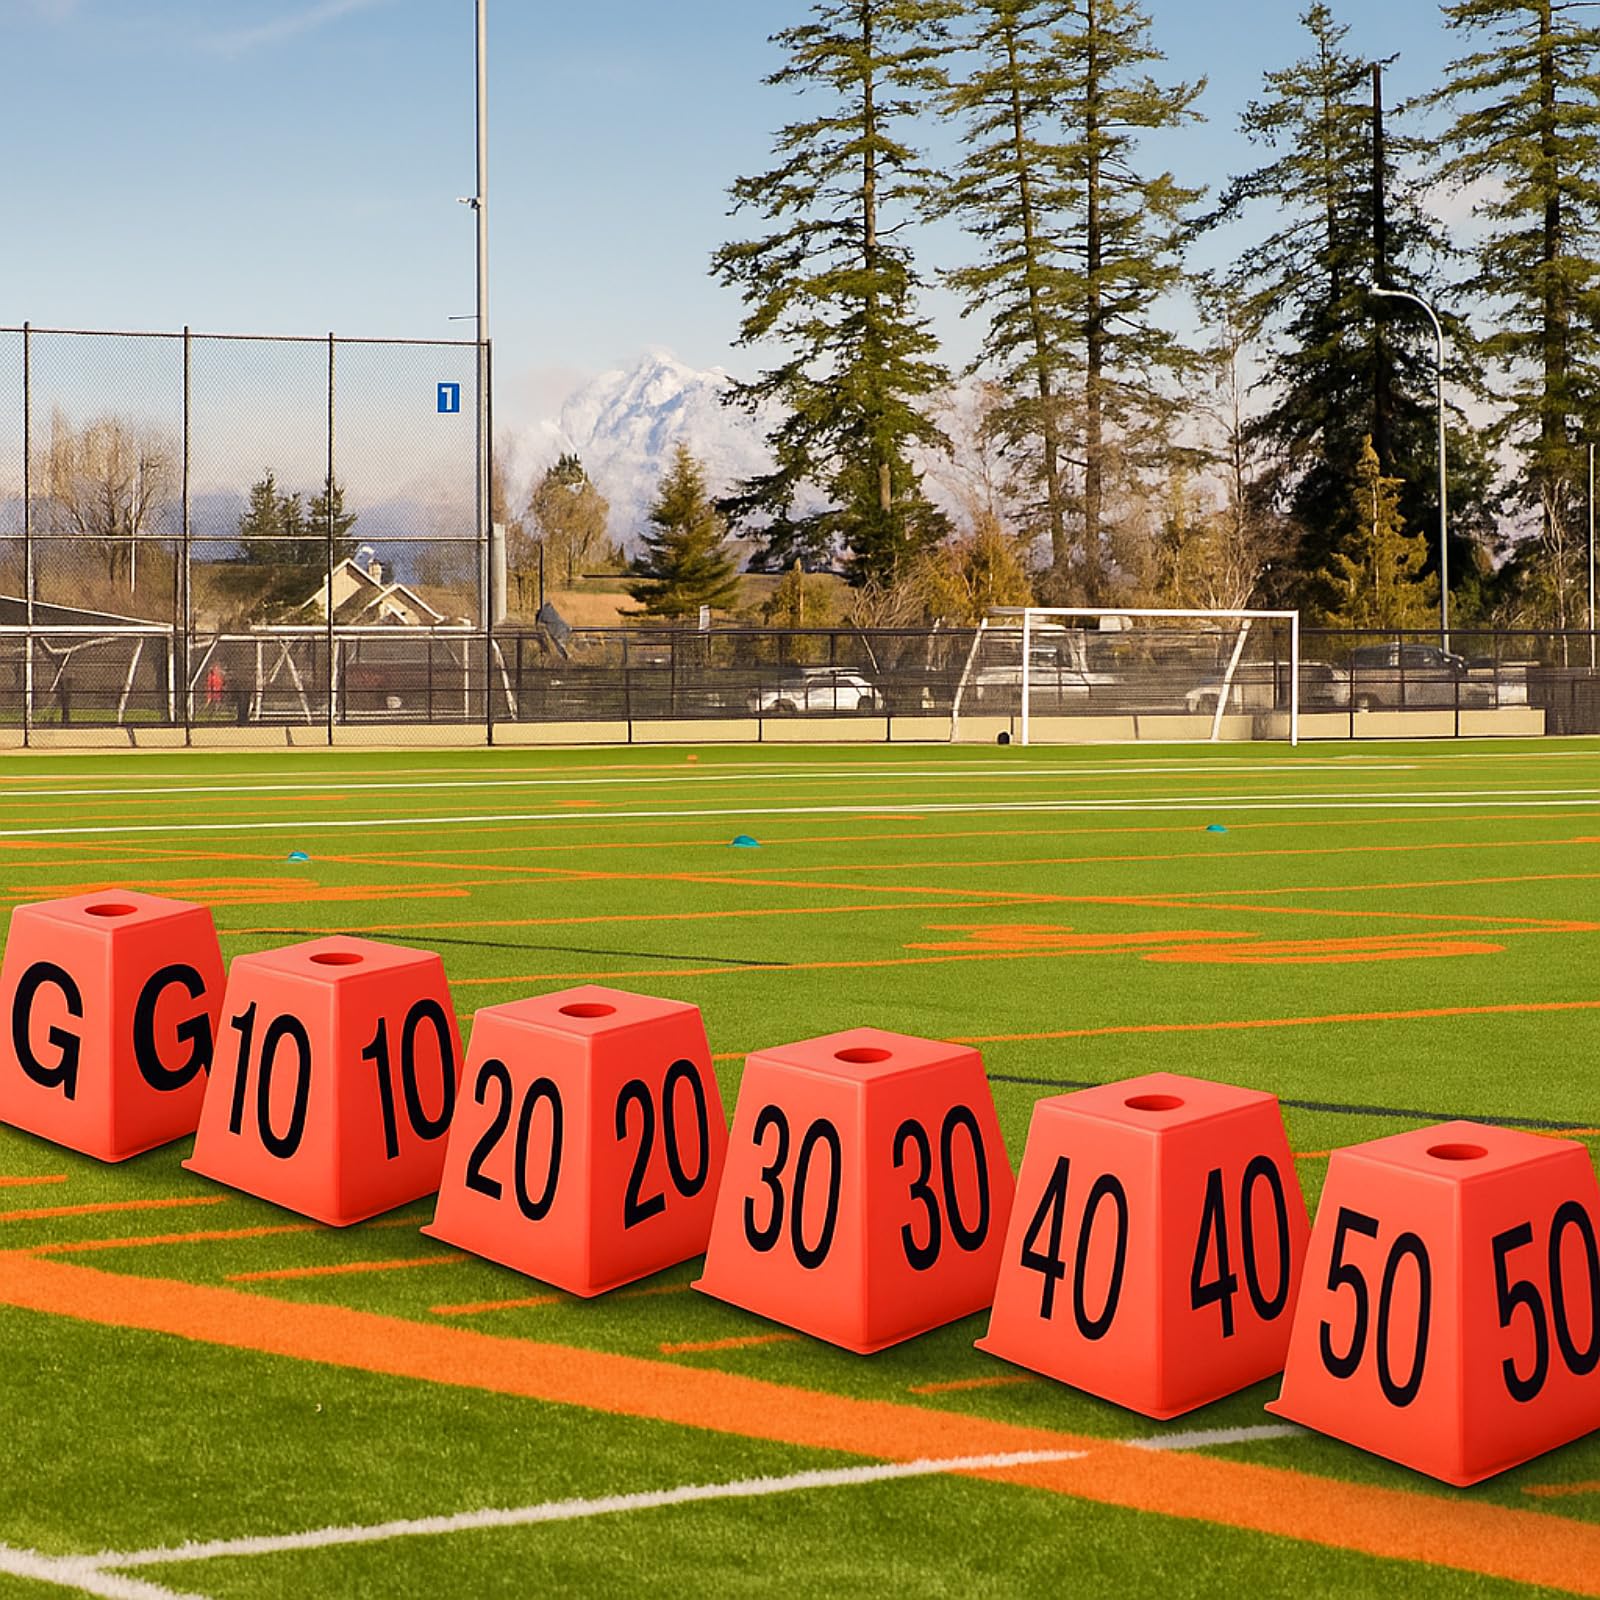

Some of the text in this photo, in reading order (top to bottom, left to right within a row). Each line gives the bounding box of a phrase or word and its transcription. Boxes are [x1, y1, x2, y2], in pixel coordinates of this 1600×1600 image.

[441, 387, 453, 411] 1
[12, 962, 83, 1100] G
[134, 964, 213, 1091] G
[230, 1001, 311, 1159] 10
[362, 999, 456, 1160] 10
[466, 1059, 563, 1221] 20
[615, 1058, 709, 1229] 20
[744, 1104, 841, 1269] 30
[893, 1105, 990, 1271] 30
[1021, 1156, 1128, 1340] 40
[1191, 1155, 1290, 1338] 40
[1320, 1207, 1431, 1407] 50
[1492, 1201, 1600, 1403] 50
